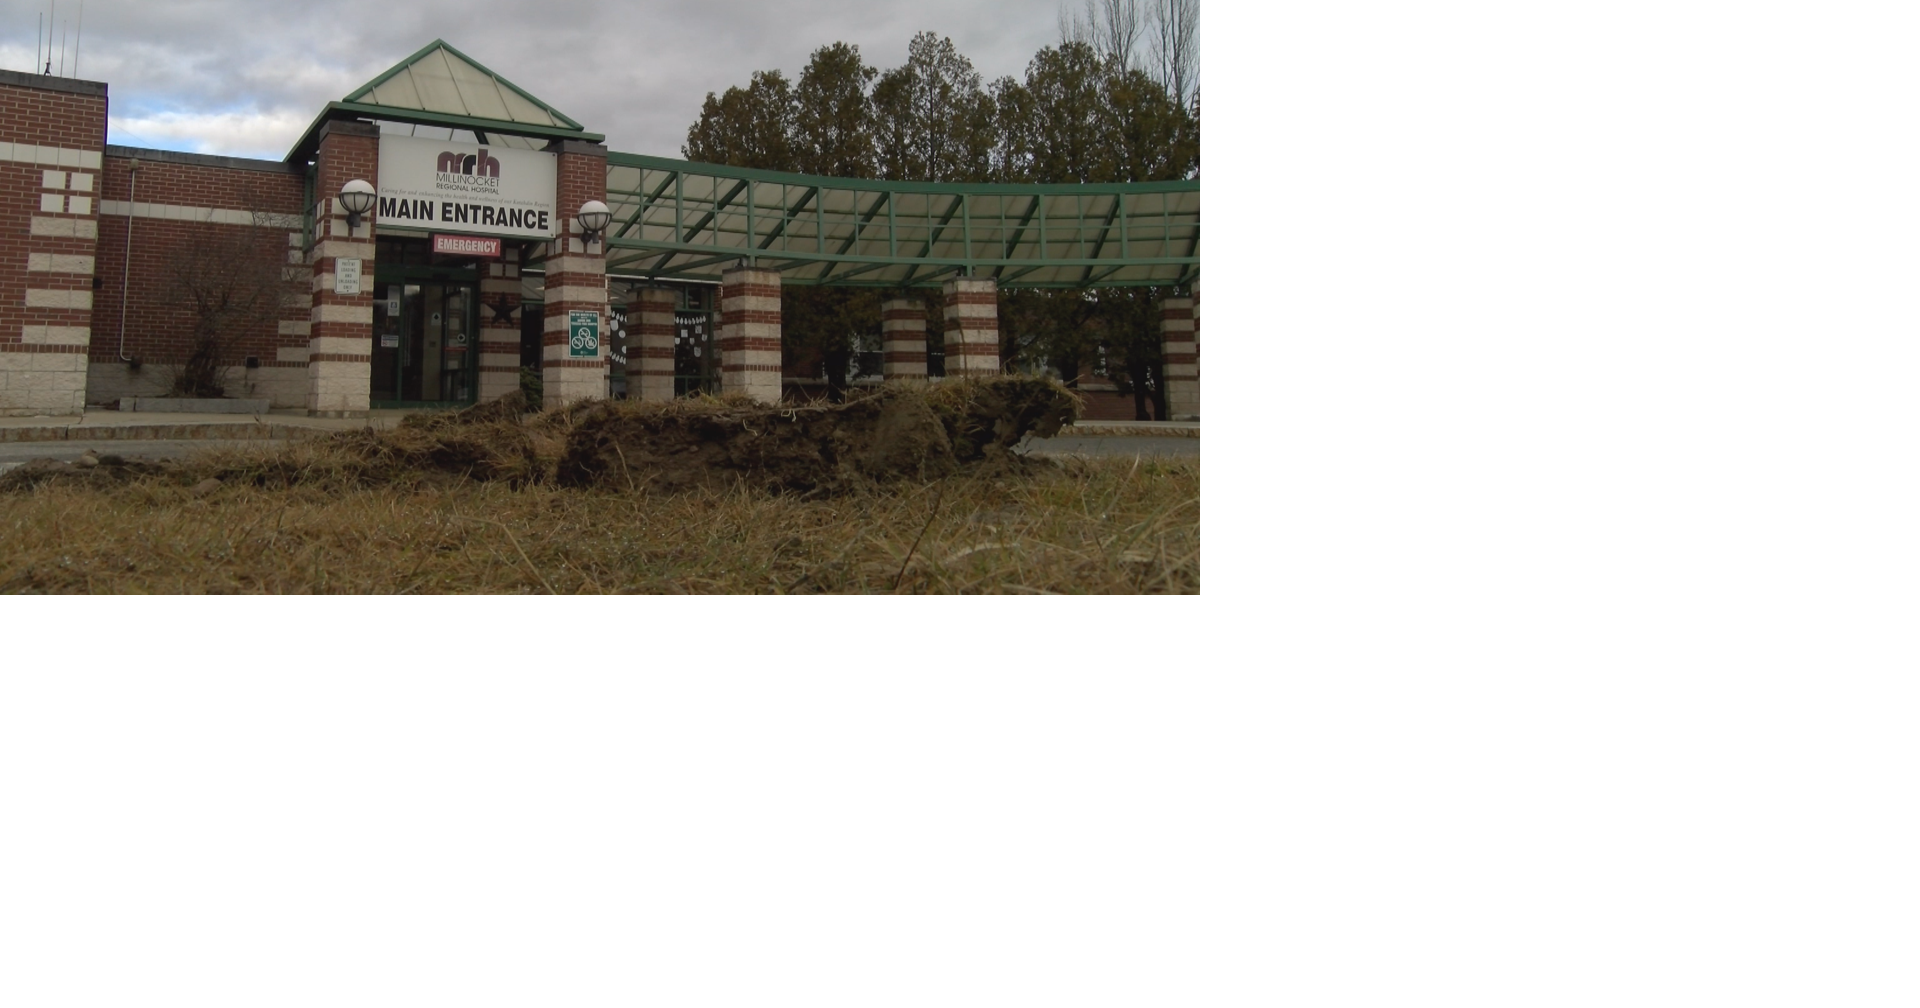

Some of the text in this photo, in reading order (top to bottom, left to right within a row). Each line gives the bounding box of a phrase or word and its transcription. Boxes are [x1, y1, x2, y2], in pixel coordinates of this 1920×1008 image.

[436, 173, 500, 187] MILLINOCKET
[381, 187, 398, 195] Caring
[418, 191, 444, 199] enhancing
[436, 183, 499, 195] REGIONAL HOSPITAL
[379, 196, 549, 230] MAIN ENTRANCE
[437, 238, 497, 253] EMERGENCY
